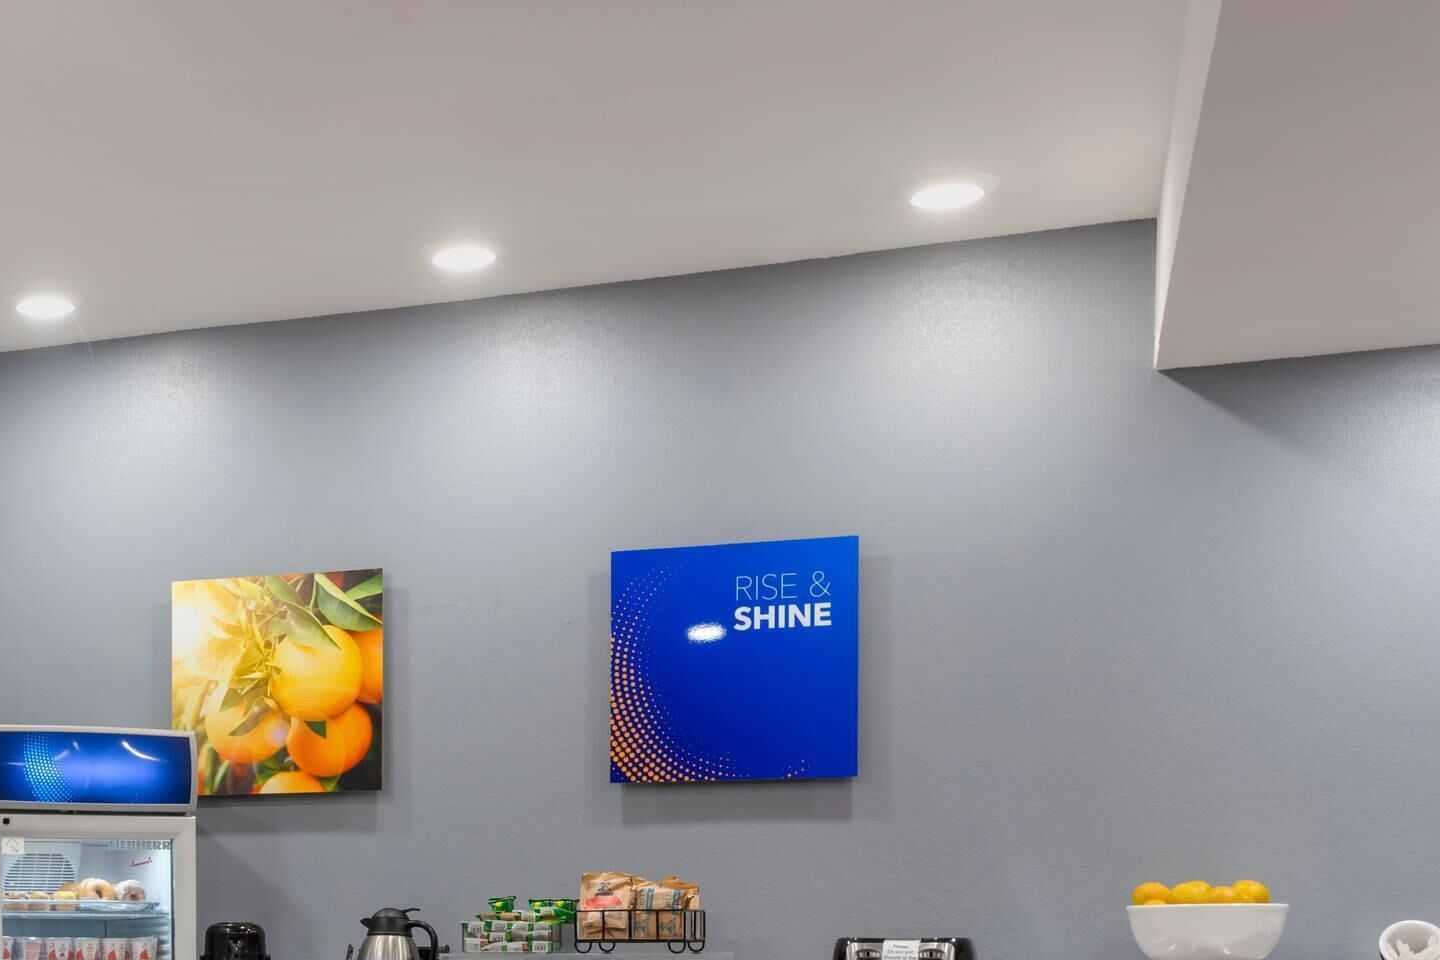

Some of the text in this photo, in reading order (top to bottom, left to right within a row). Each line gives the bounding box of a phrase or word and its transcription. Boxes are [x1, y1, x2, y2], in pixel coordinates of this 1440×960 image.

[736, 570, 831, 601] RISE &
[733, 602, 832, 631] SHINE
